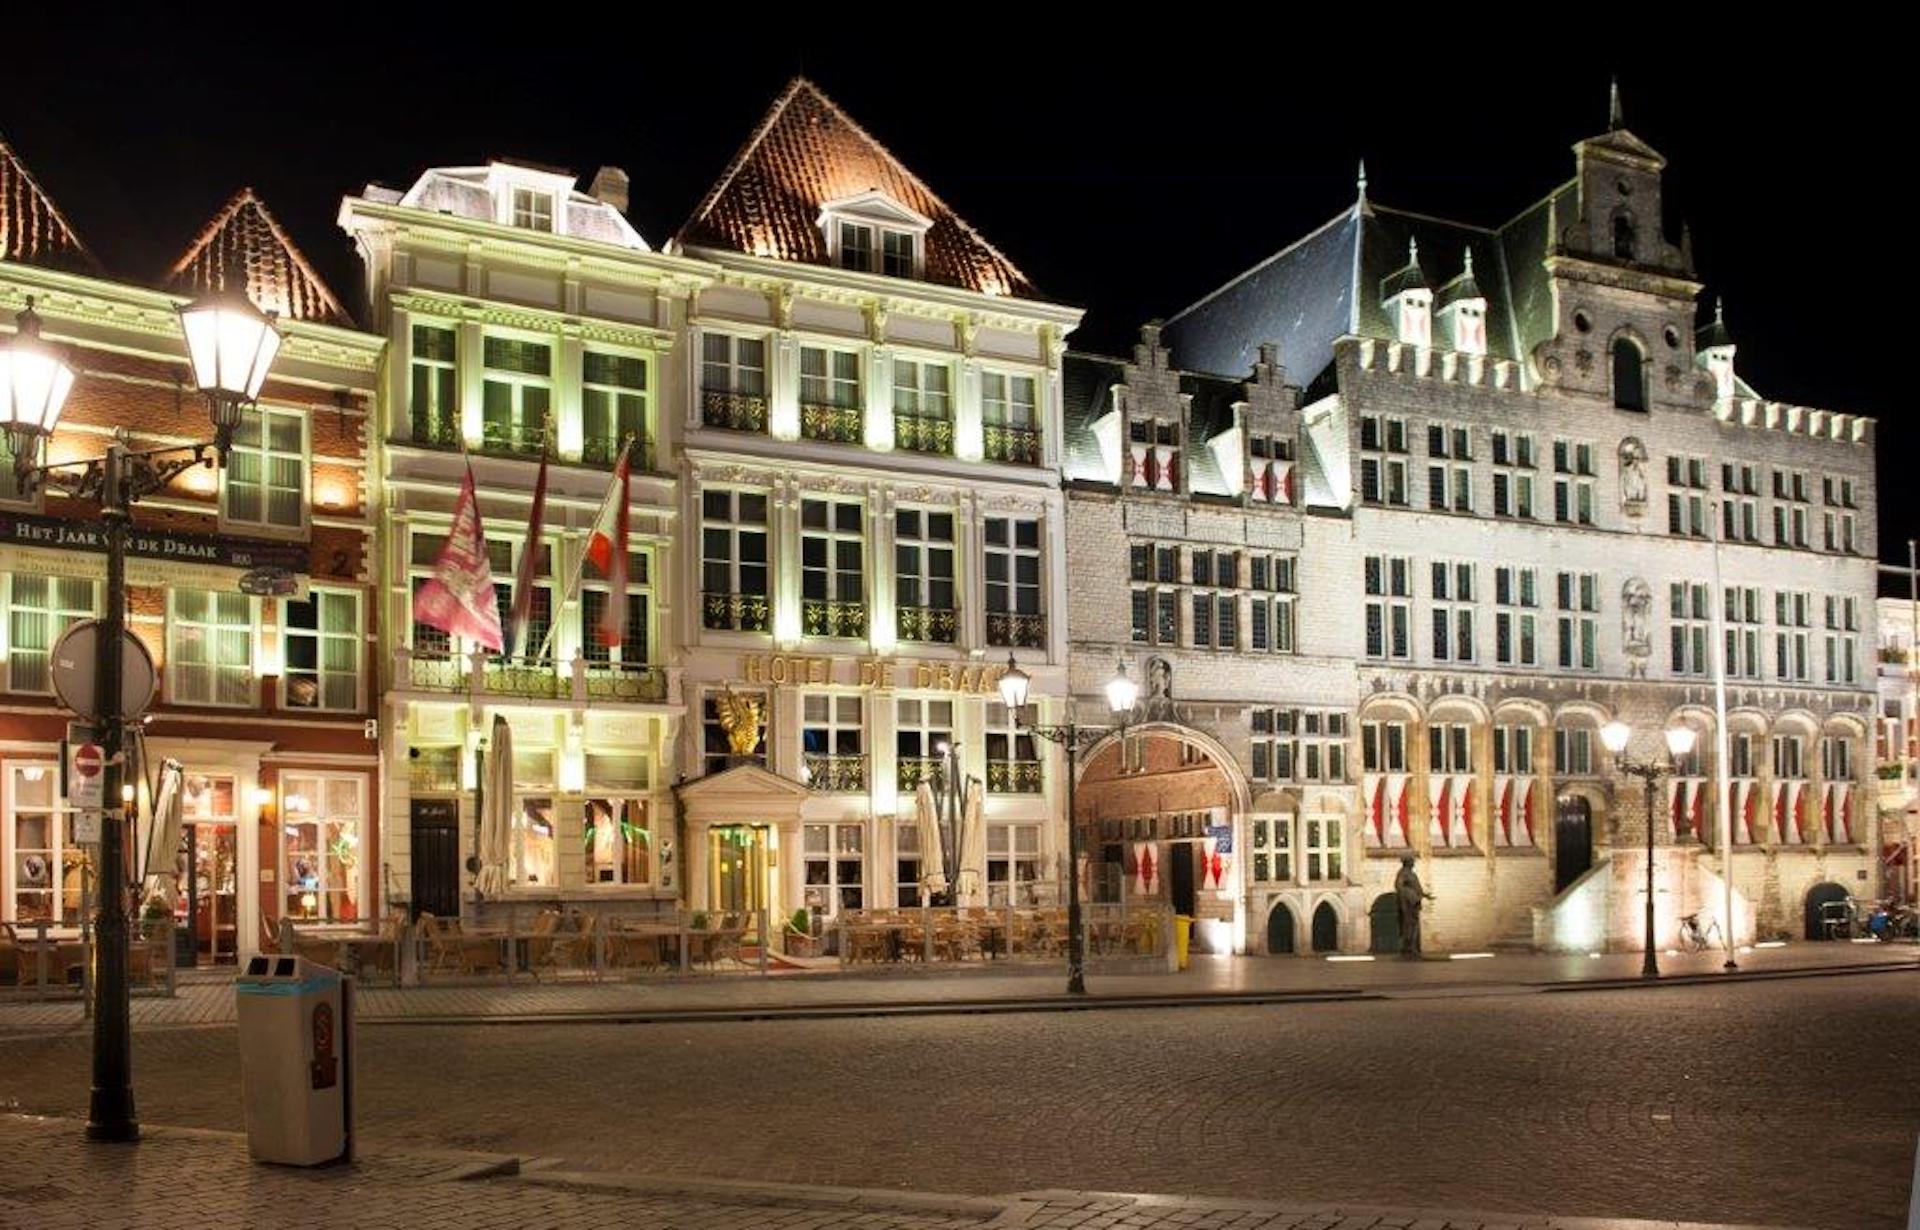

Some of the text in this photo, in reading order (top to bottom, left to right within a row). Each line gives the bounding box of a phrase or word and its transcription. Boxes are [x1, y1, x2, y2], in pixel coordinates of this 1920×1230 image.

[57, 526, 98, 545] JAAR
[138, 539, 159, 552] DE
[163, 540, 217, 558] DRAAK
[744, 655, 840, 686] HOTEL
[857, 660, 896, 690] DE
